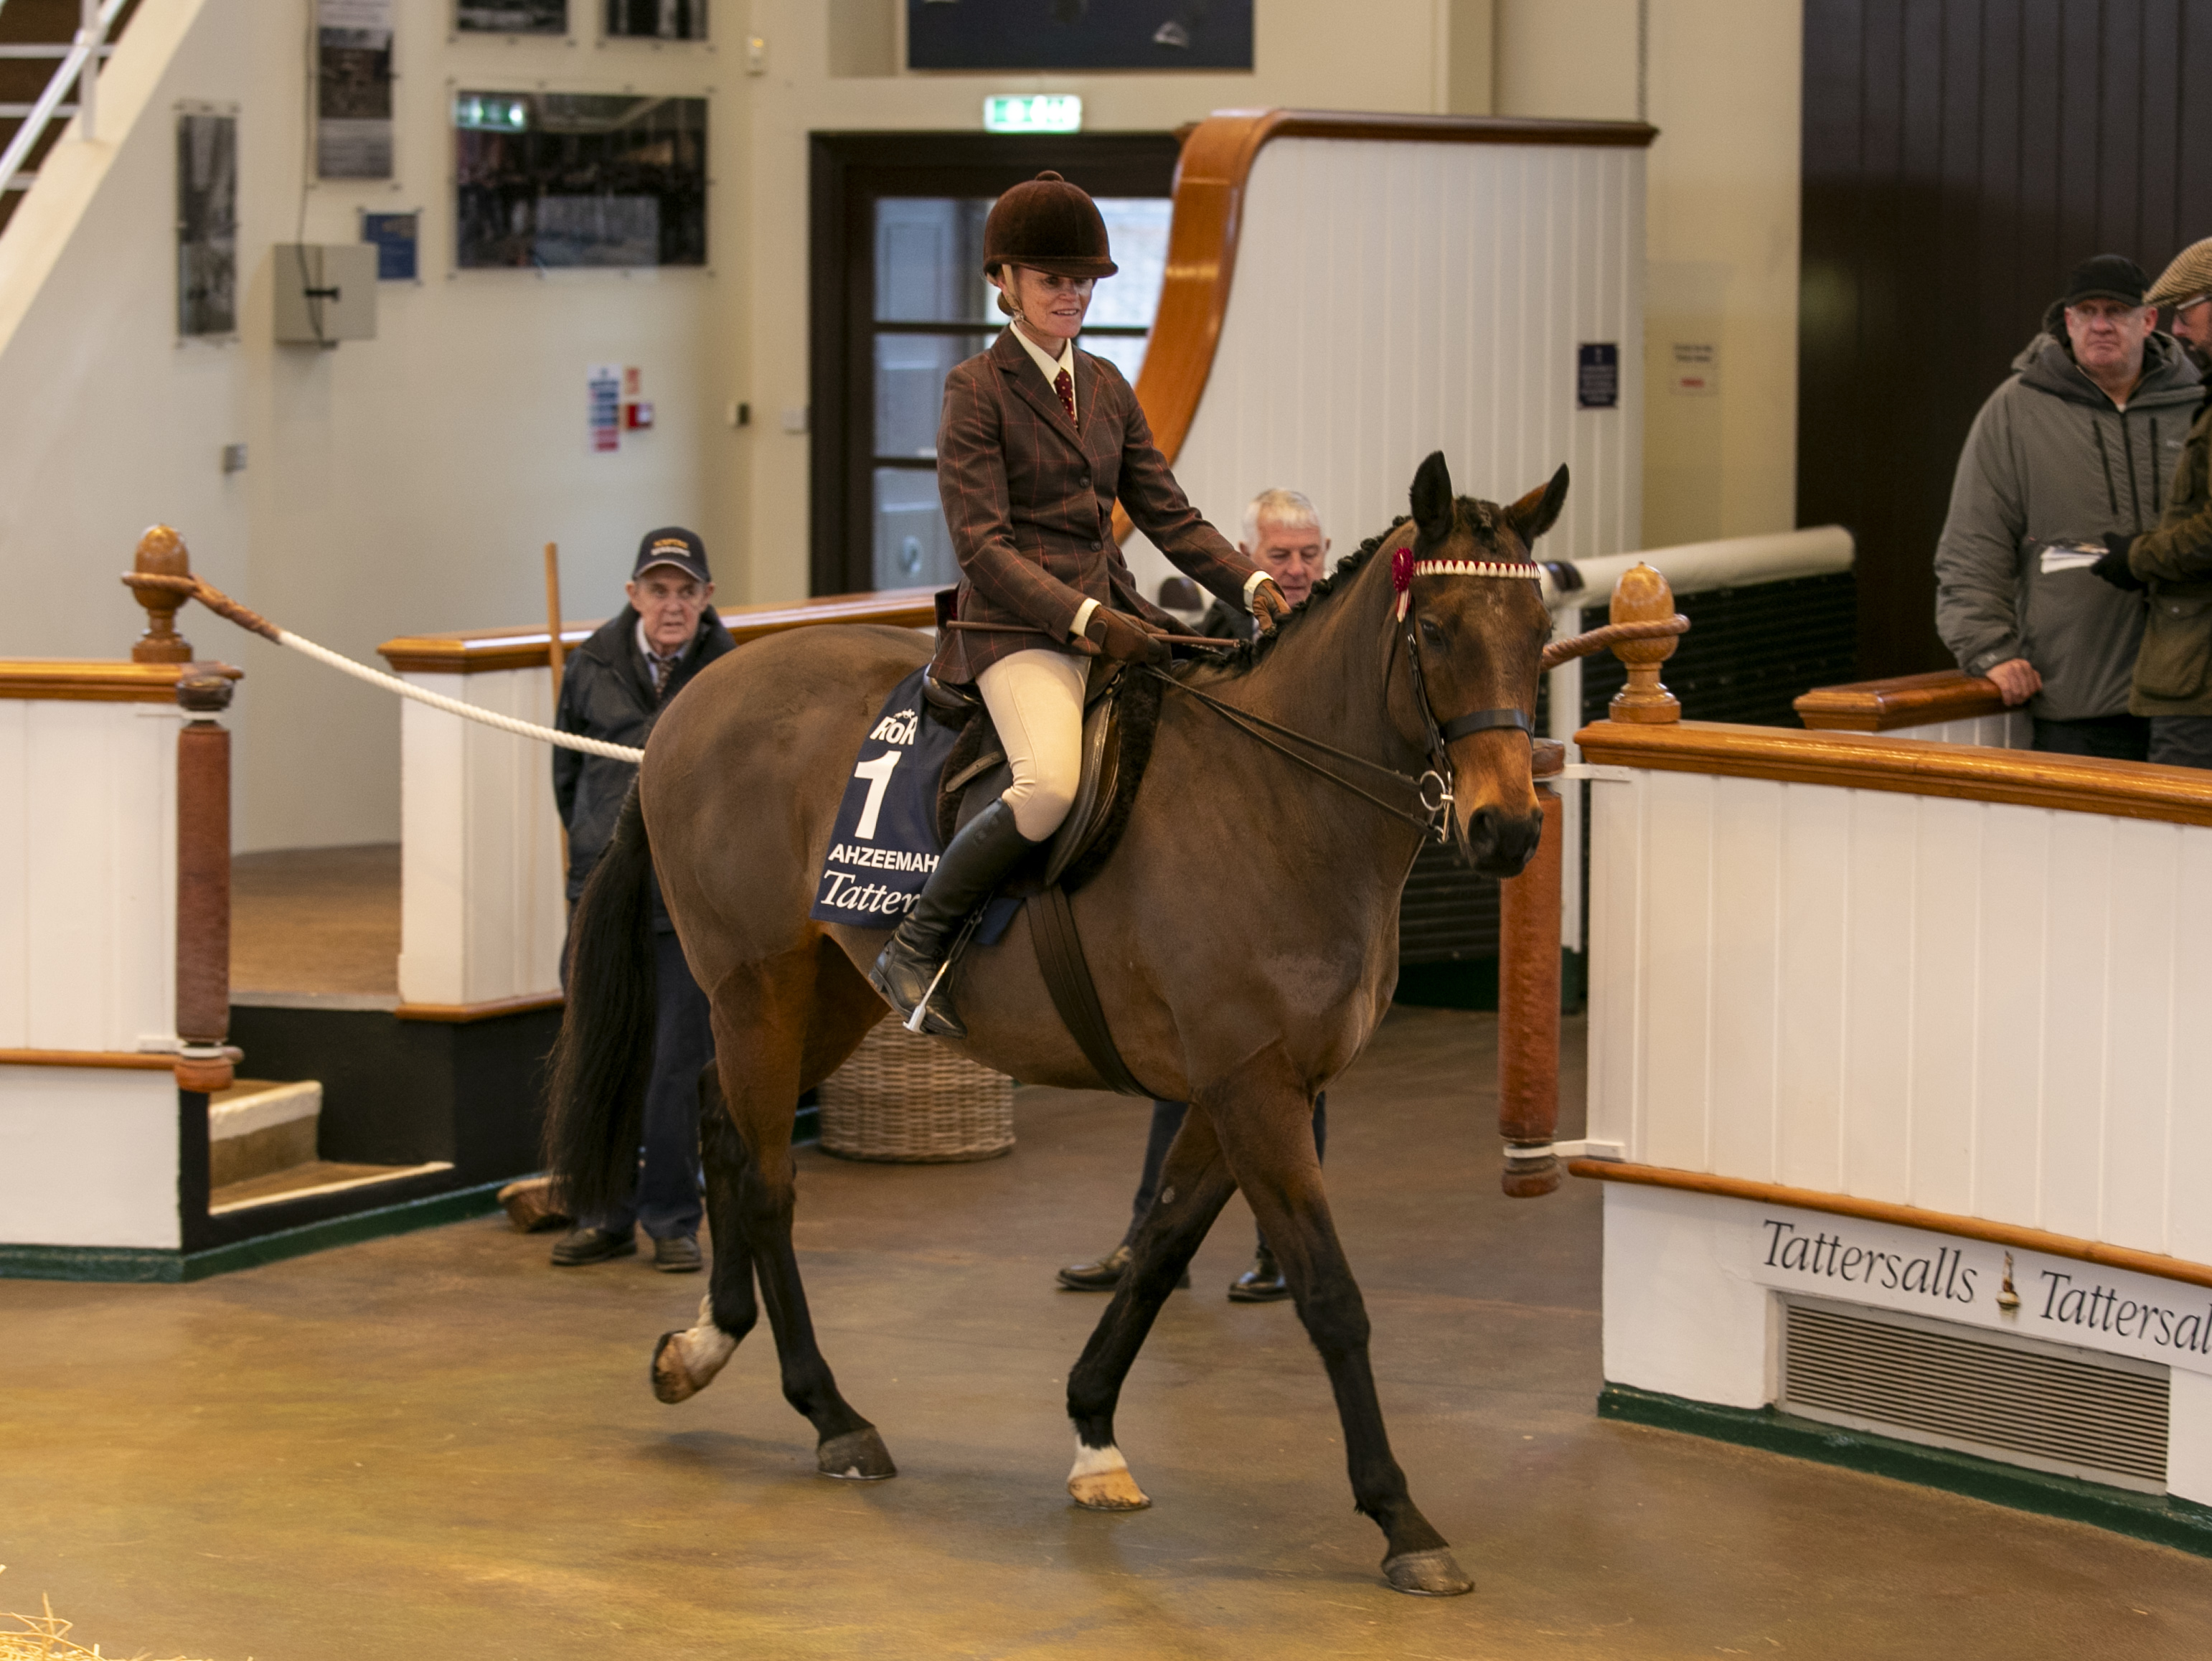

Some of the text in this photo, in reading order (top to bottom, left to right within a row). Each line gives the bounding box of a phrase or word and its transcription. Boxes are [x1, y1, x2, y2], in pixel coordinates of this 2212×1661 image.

[854, 750, 902, 839] 1
[828, 843, 940, 873] AHZEEMAH
[1763, 1219, 1978, 1303] Tattersalls
